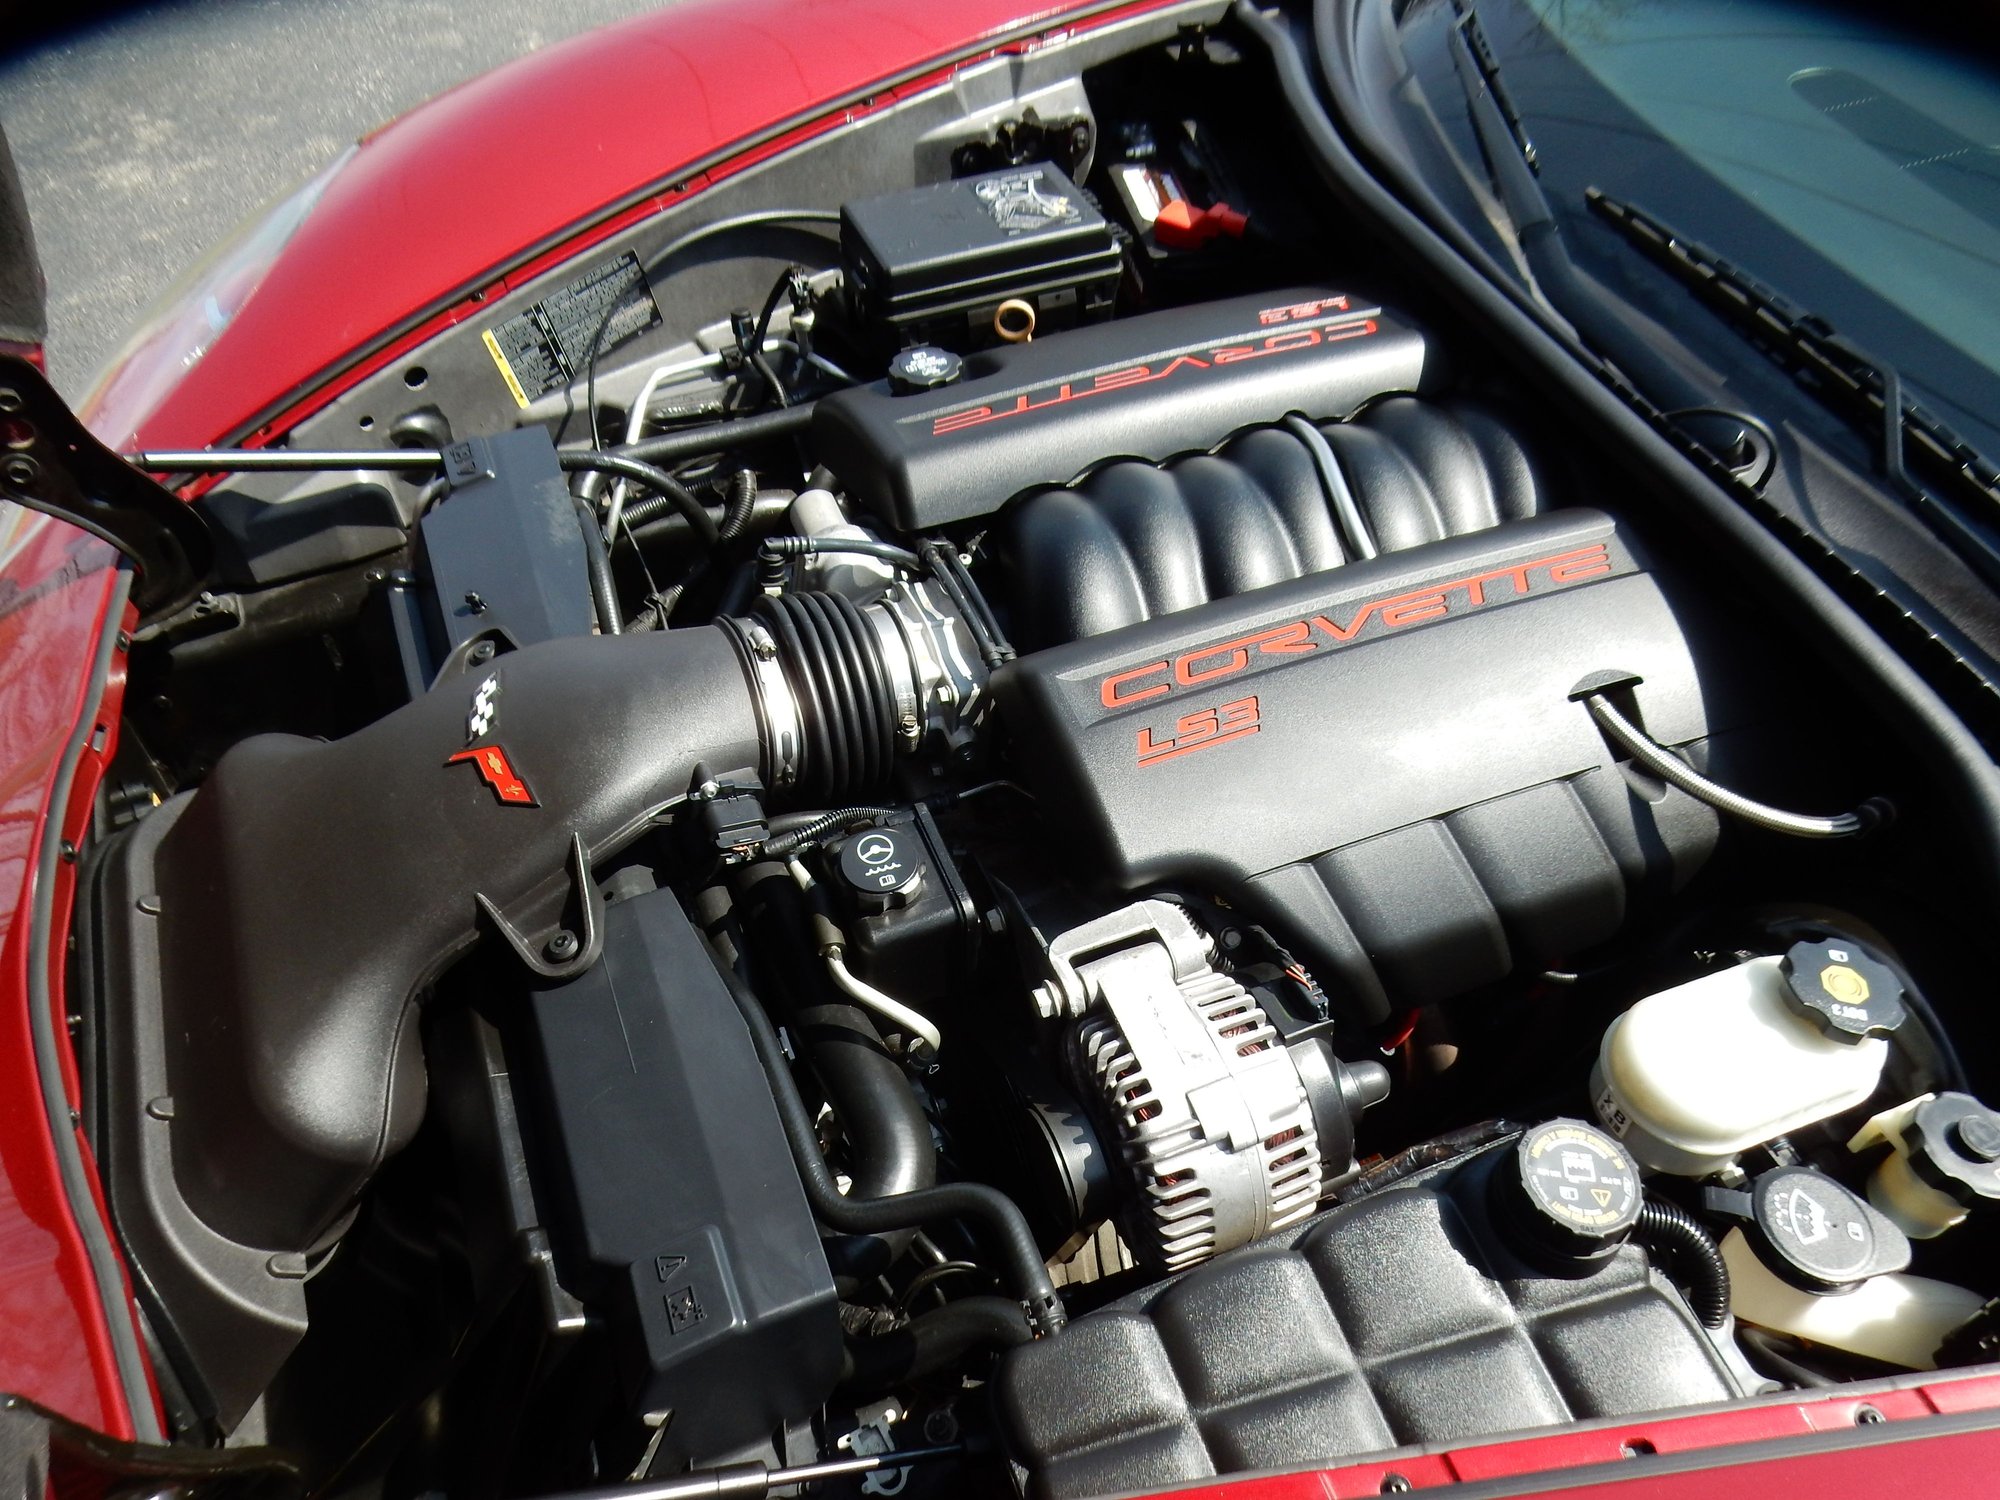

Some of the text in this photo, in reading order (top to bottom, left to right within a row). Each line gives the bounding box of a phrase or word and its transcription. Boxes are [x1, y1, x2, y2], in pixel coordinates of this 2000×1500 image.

[933, 319, 1378, 435] CORVETTE
[1101, 543, 1610, 708] CORVETTE
[1137, 695, 1260, 758] LS3
